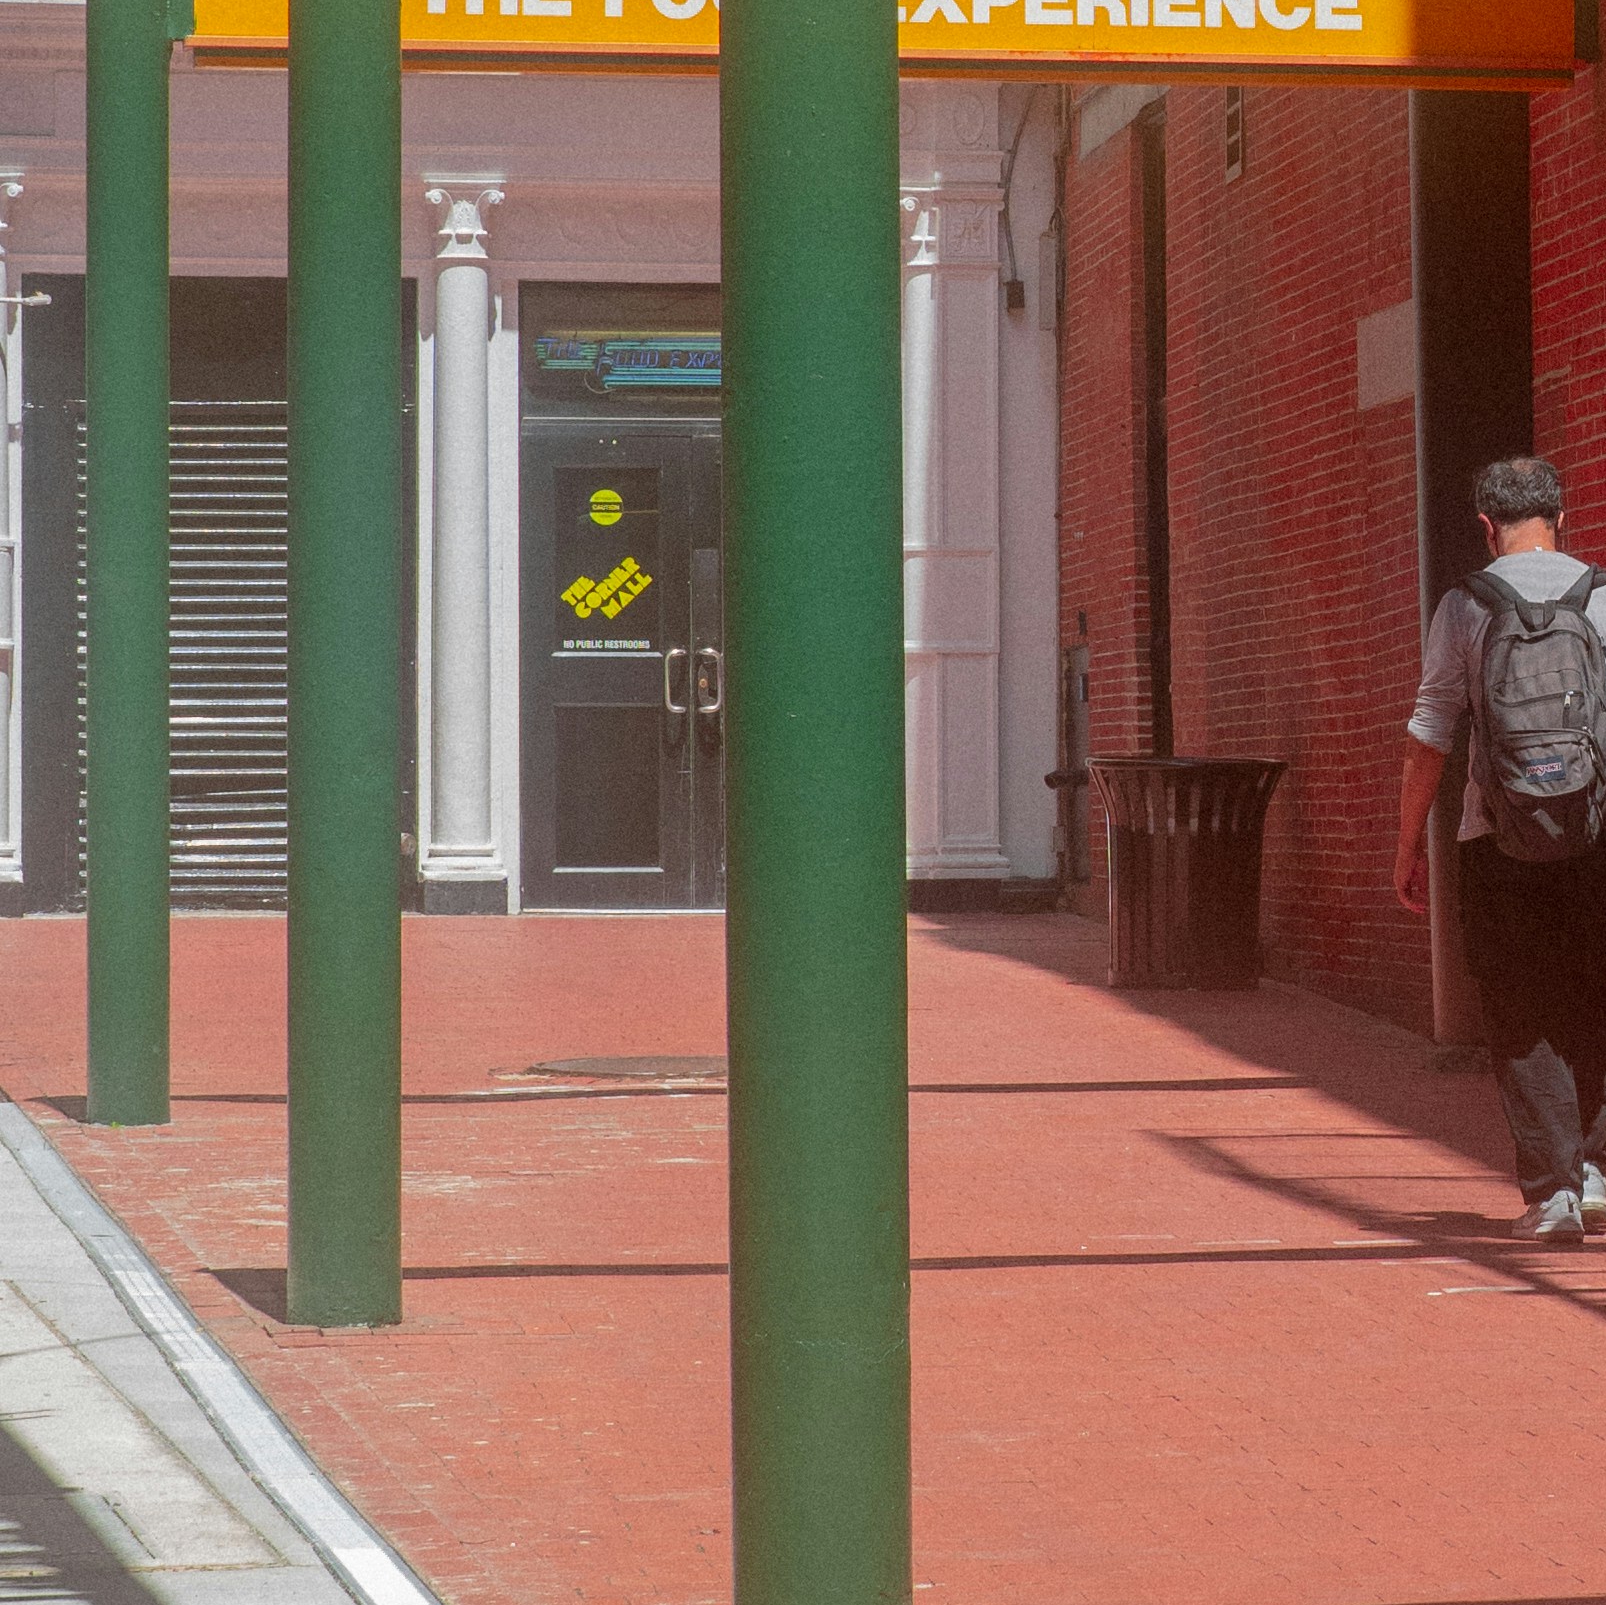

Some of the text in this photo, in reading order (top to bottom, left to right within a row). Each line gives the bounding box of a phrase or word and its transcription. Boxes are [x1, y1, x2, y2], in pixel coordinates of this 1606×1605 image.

[560, 575, 596, 606] THE
[575, 556, 641, 619] CORNER
[600, 572, 653, 620] MALL
[563, 639, 650, 649] NO PUBLIC RESTROOMS
